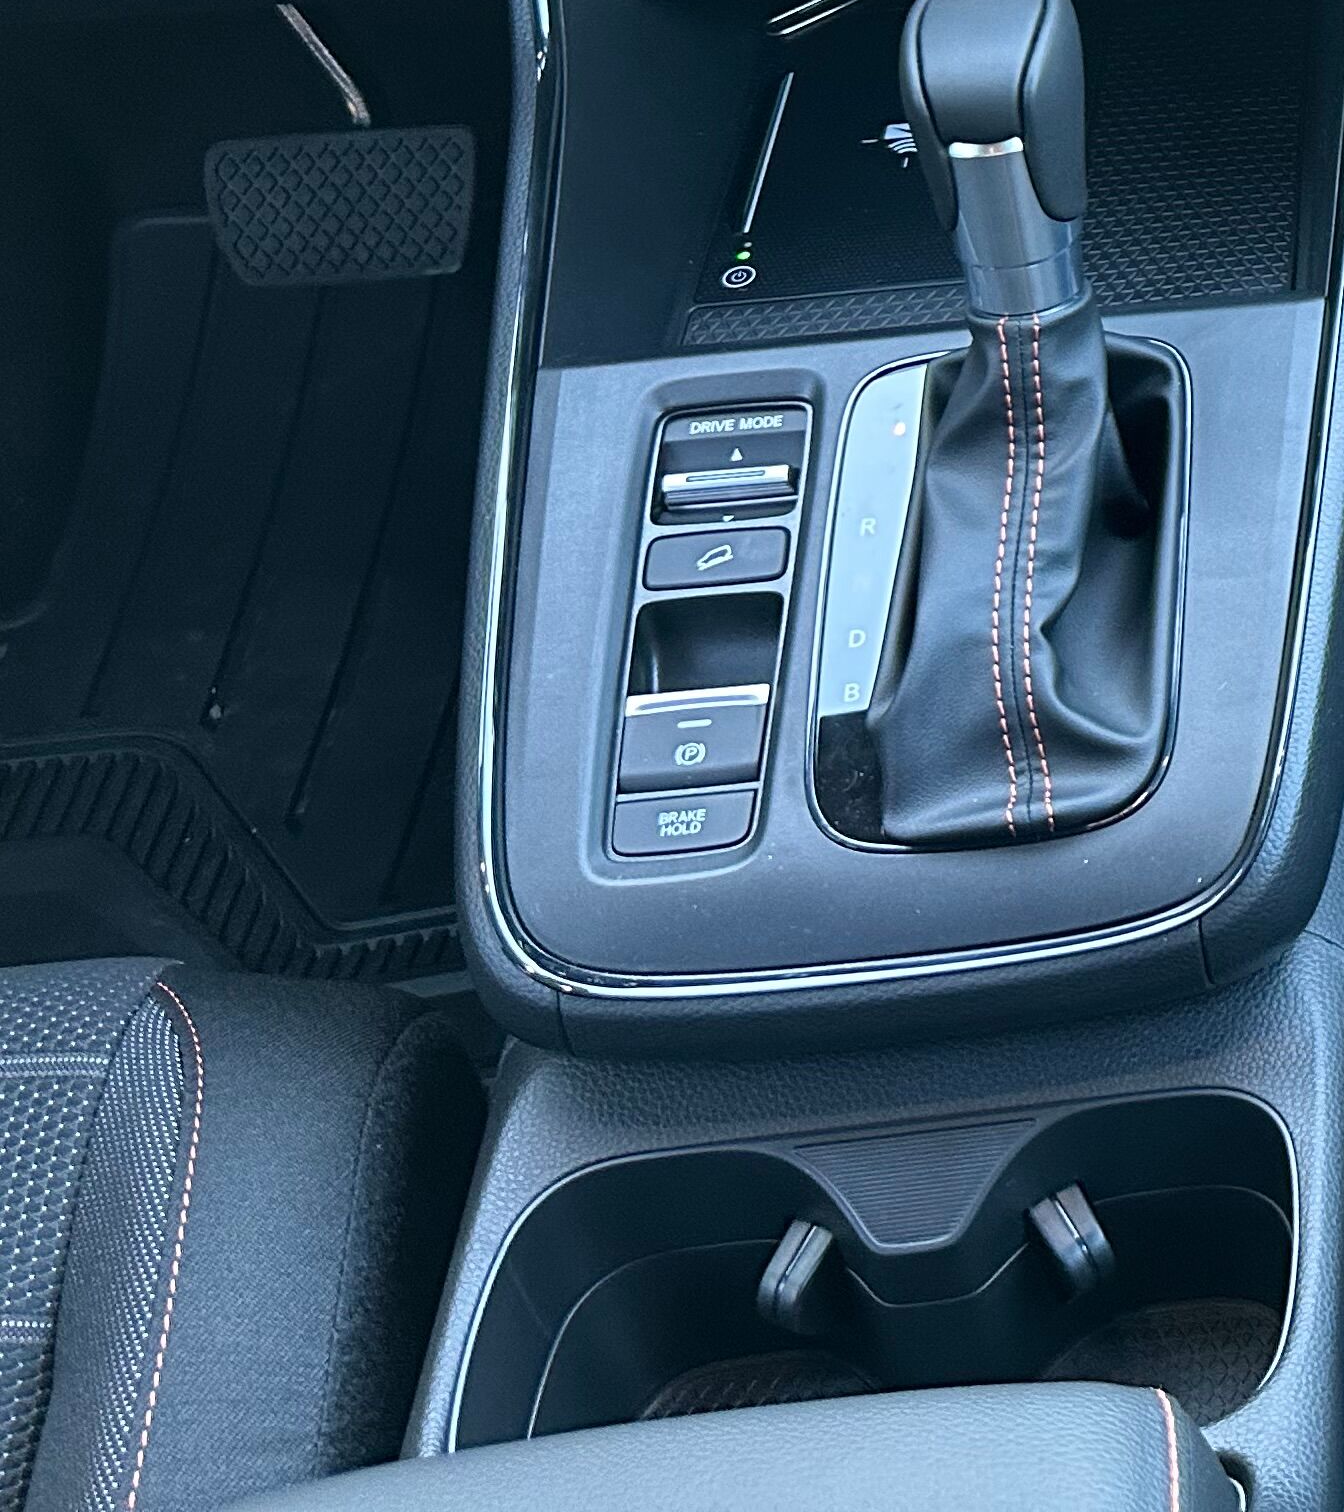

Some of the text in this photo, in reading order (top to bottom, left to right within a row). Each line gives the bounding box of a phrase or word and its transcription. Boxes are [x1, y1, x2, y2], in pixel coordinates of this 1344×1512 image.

[689, 415, 783, 435] DRIVE MODE
[861, 518, 875, 536] R
[849, 629, 865, 648] D
[844, 683, 861, 702] B
[658, 809, 706, 825] BRAKE
[660, 821, 701, 836] HOLD
